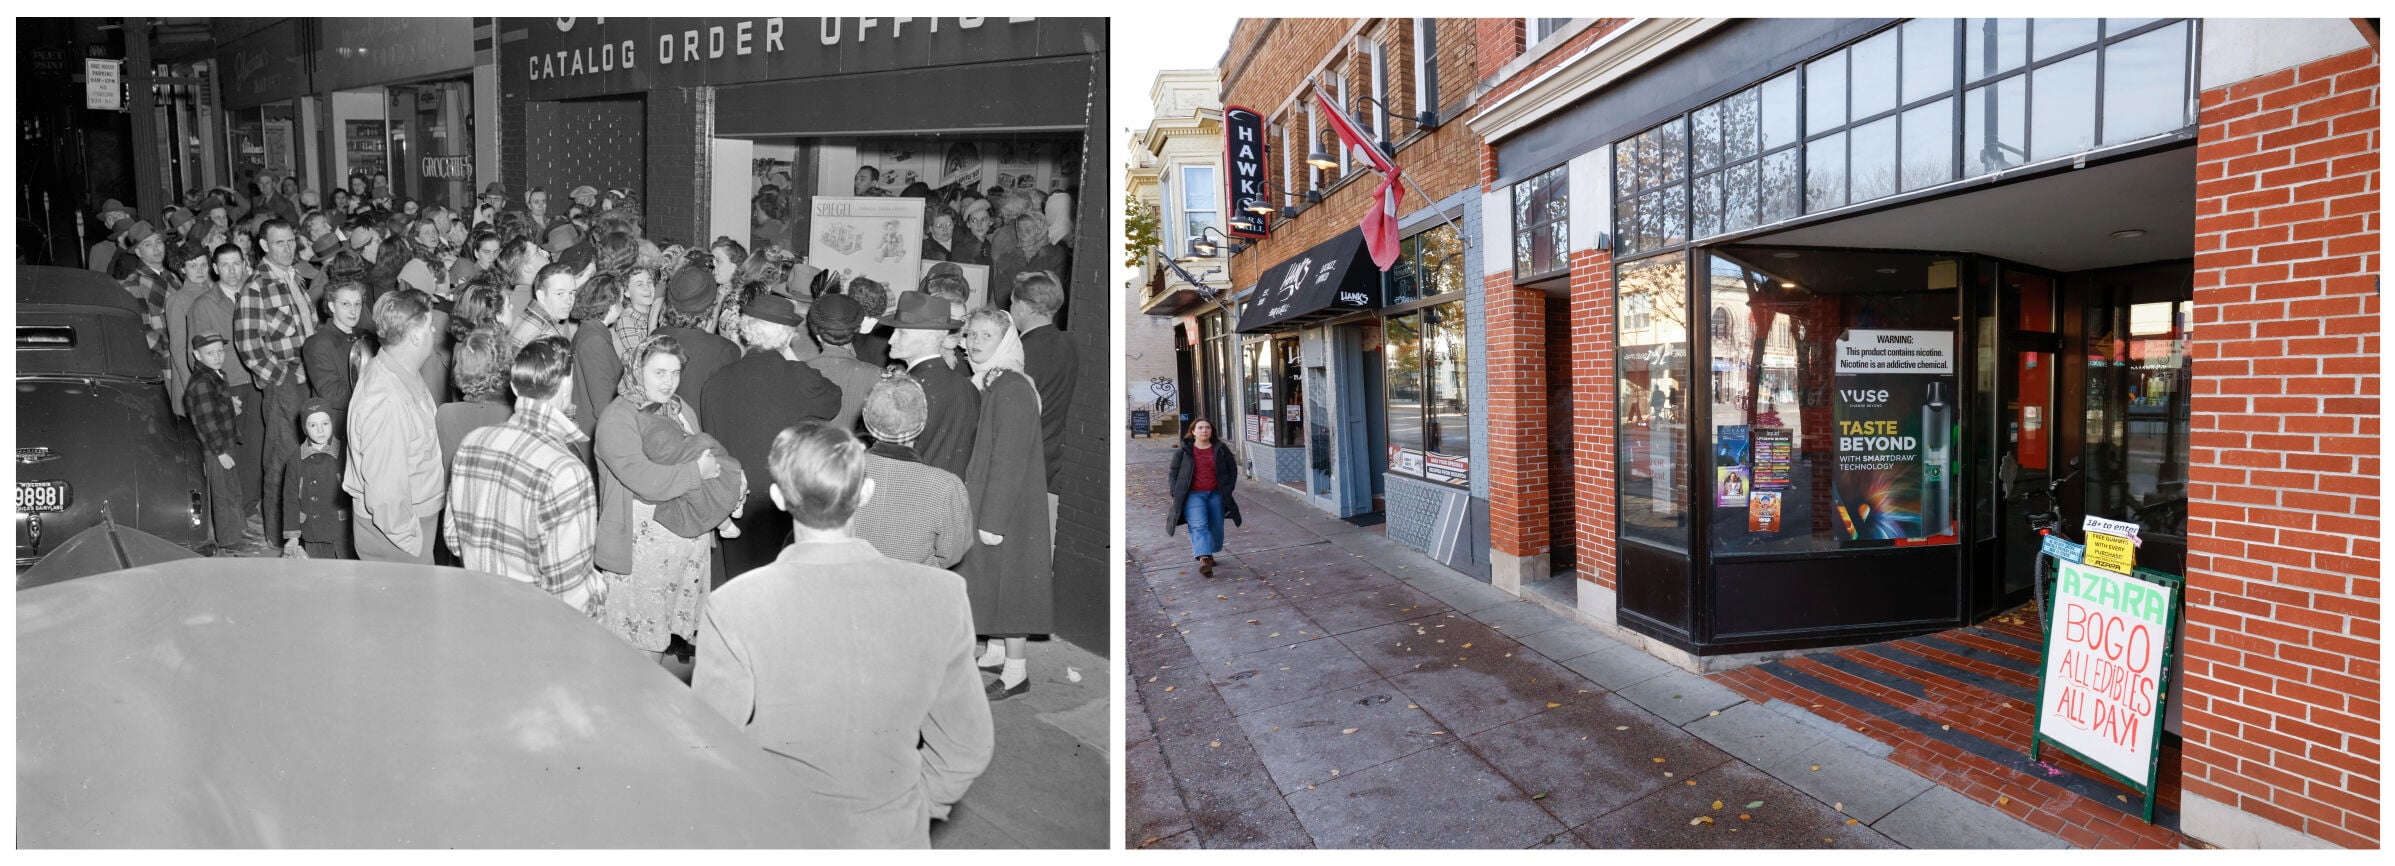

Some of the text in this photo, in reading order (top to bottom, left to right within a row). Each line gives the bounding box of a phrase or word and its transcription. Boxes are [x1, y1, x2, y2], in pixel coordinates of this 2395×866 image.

[529, 40, 635, 81] CATALOG
[659, 17, 785, 65] ORDER
[816, 202, 853, 217] SPIEGEL
[1876, 334, 1914, 345] WARNING:
[1846, 346, 1944, 358] This product contains nicotine.
[1840, 359, 1869, 369] Nicotine
[1869, 359, 1876, 369] is
[1886, 360, 1916, 369] addictive
[1917, 360, 1949, 369] chemical.
[1839, 420, 1898, 436] TASTE
[1839, 436, 1917, 452] BEYOND
[1839, 455, 1862, 463] WITH
[1839, 463, 1894, 471] TECHNOLOGY
[16, 486, 64, 507] 98981
[2086, 519, 2139, 533] 18+ to enter
[2095, 560, 2121, 571] AZARA
[2062, 567, 2165, 625] AZARA
[2066, 603, 2150, 674] BOGO
[2059, 649, 2089, 688] ALL
[2057, 686, 2139, 753] ALL DAY!
